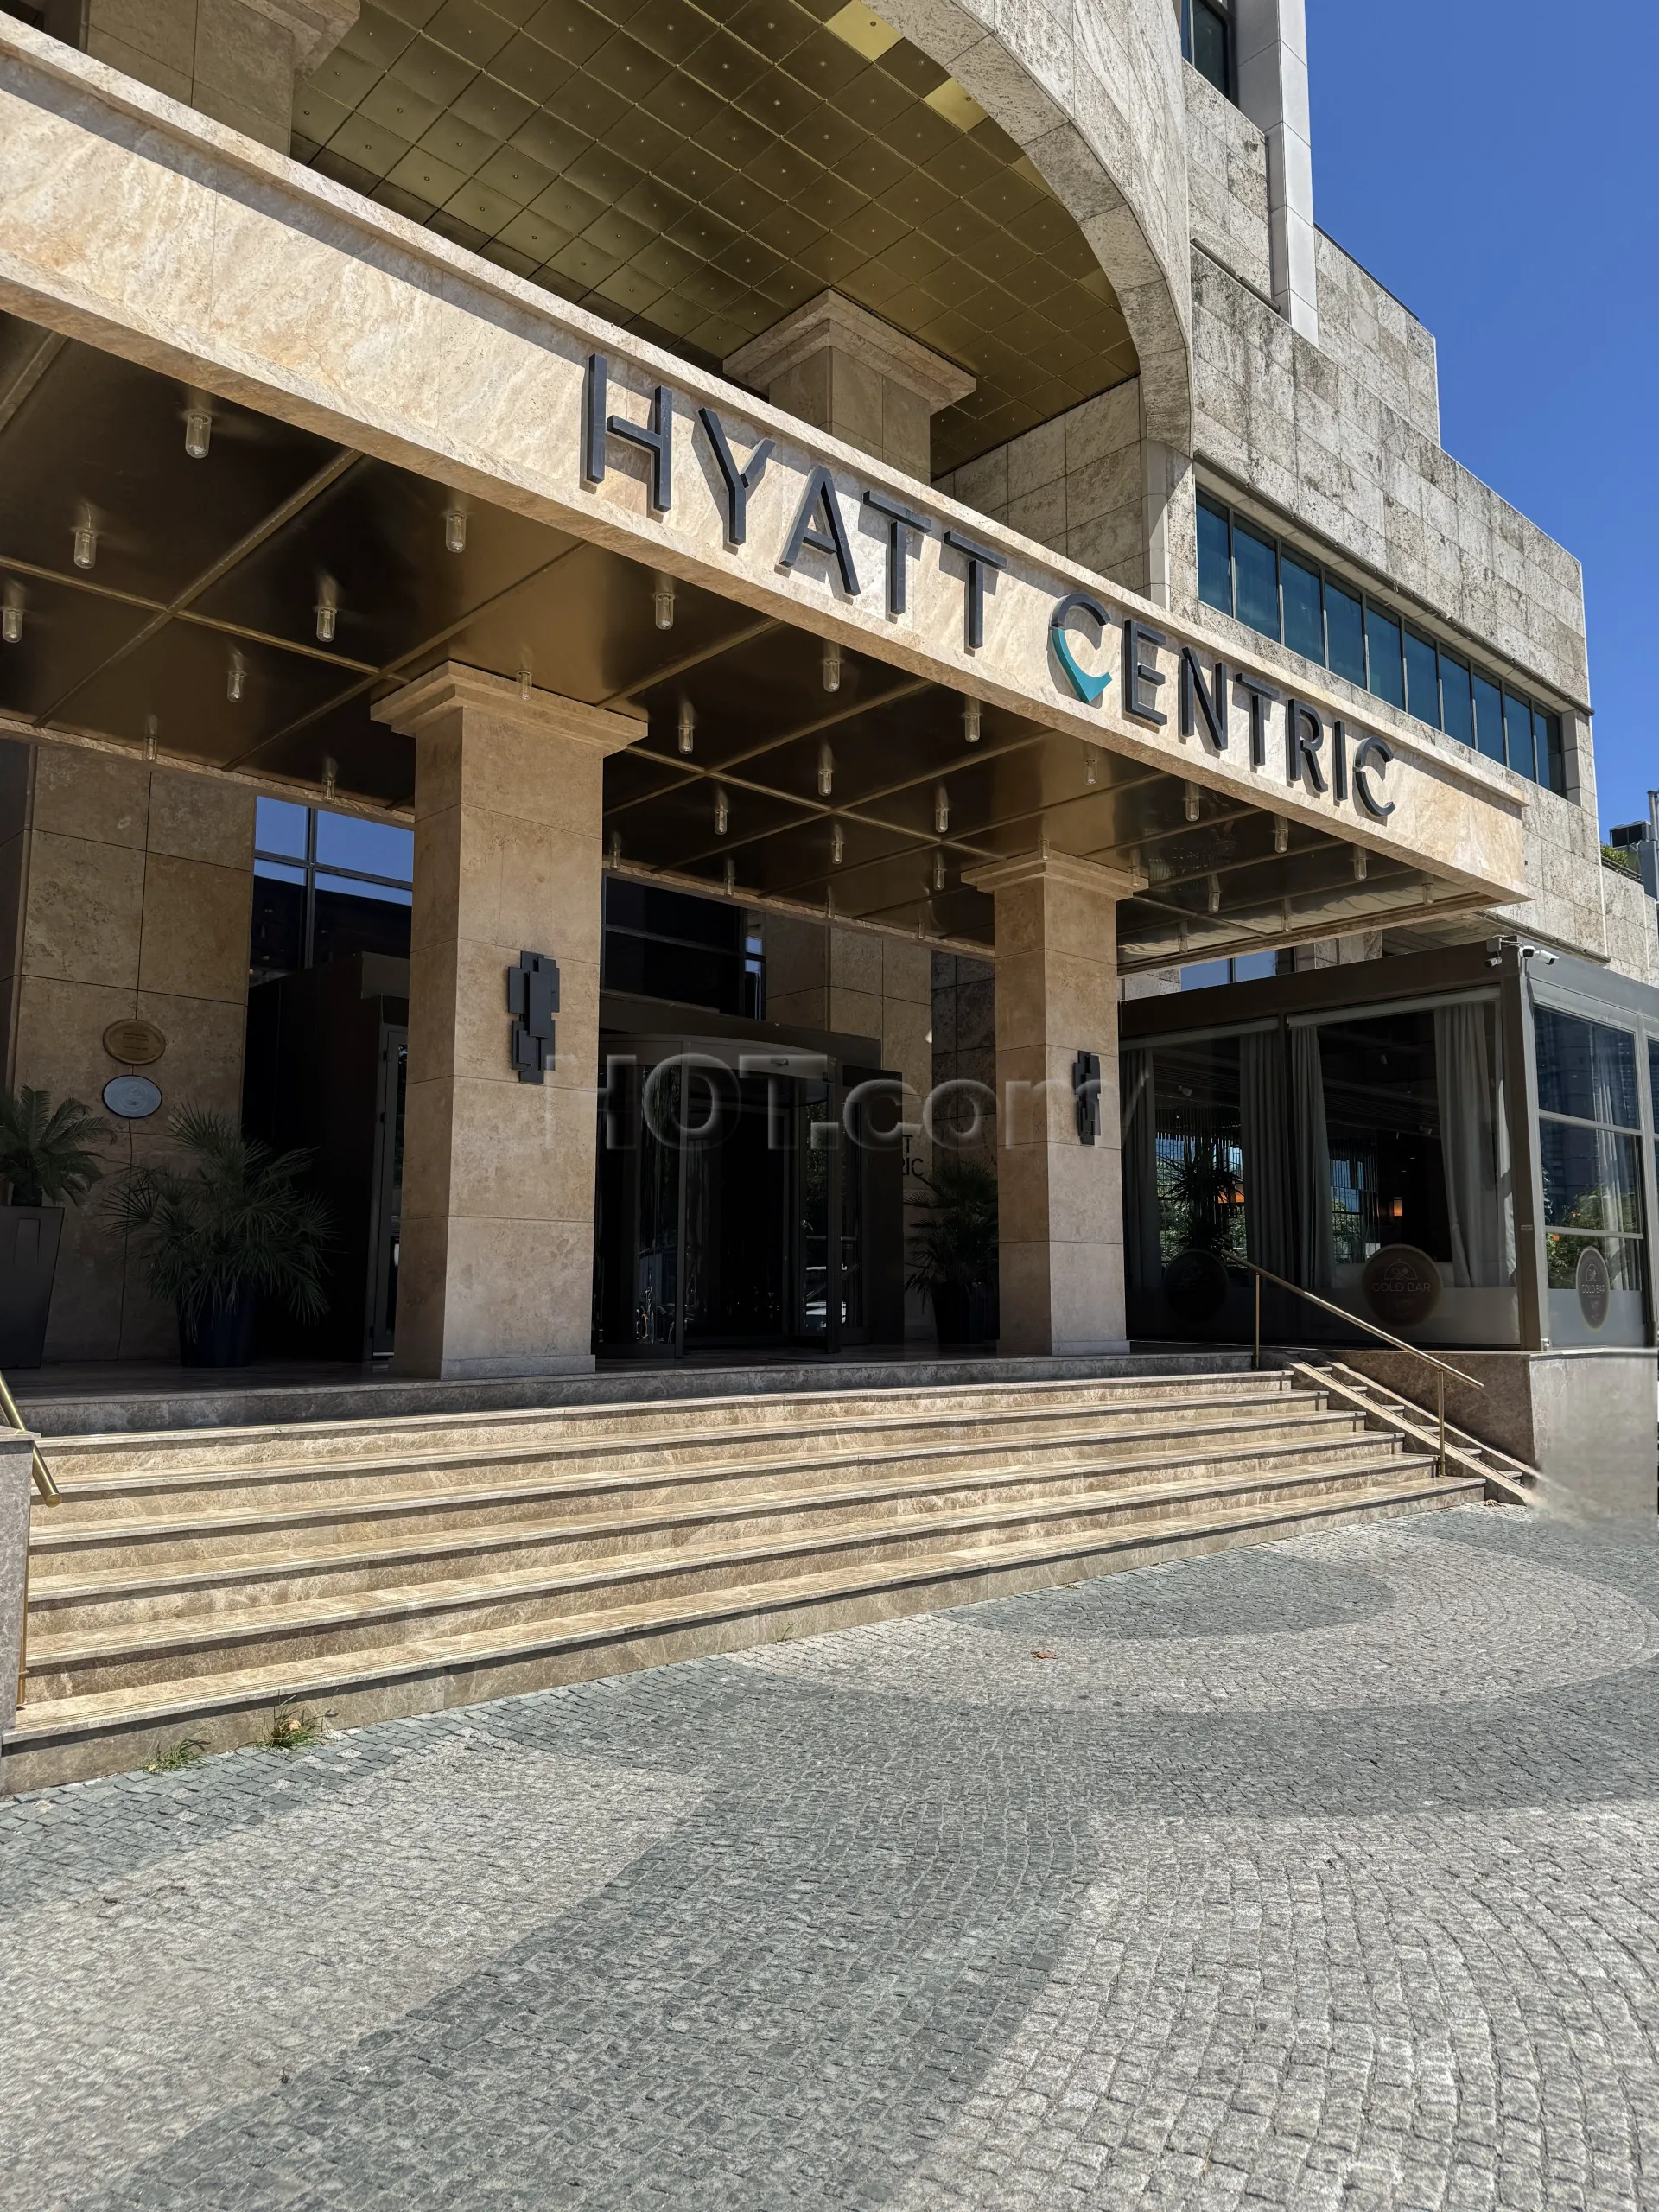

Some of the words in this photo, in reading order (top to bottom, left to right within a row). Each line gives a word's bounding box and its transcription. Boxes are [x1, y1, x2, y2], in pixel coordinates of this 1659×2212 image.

[586, 353, 1007, 650] HYATT
[1049, 592, 1396, 817] CENTRIC
[1371, 1282, 1404, 1292] GOLD
[1407, 1282, 1431, 1292] BAR
